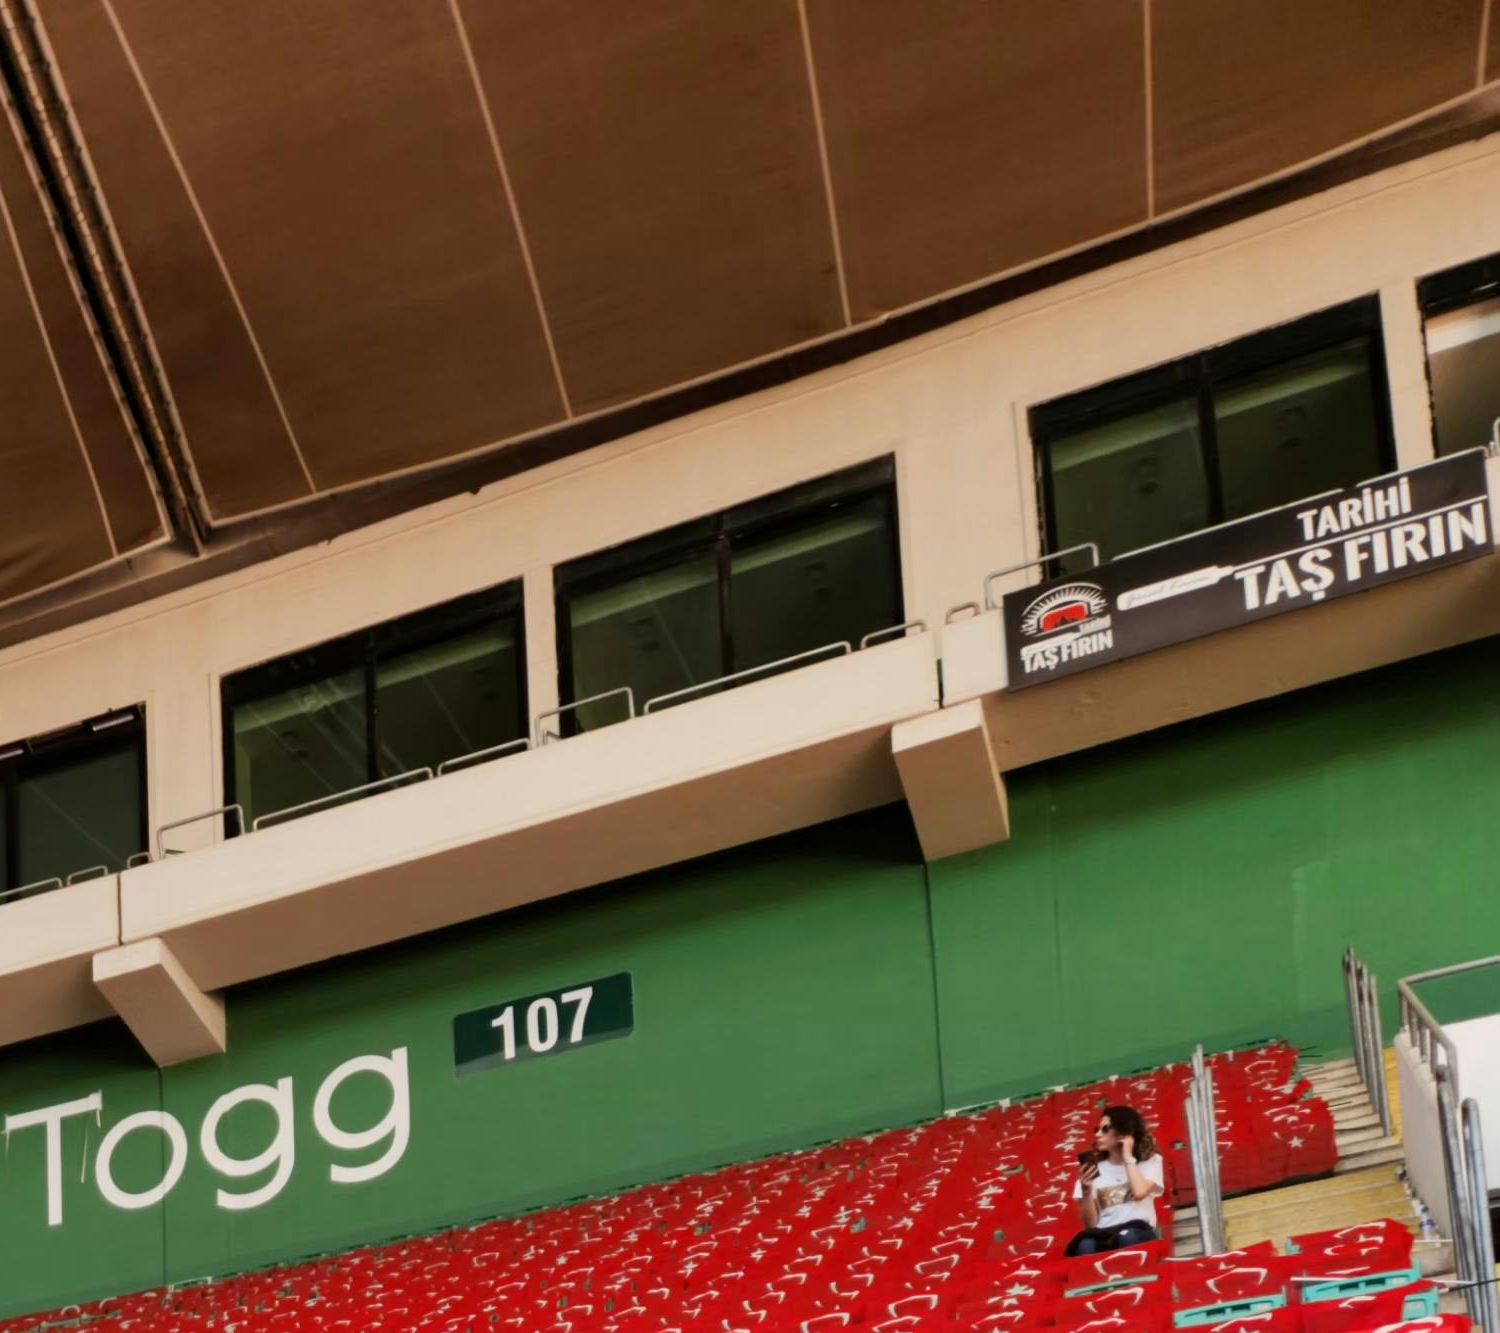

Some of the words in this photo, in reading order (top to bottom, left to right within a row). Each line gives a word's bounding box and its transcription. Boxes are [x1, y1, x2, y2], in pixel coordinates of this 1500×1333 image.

[1297, 476, 1412, 541] TARİHİ
[1233, 548, 1334, 611] TAŞ
[1344, 502, 1487, 582] FIRIN
[491, 987, 595, 1060] 107
[0, 1046, 411, 1227] Togg
